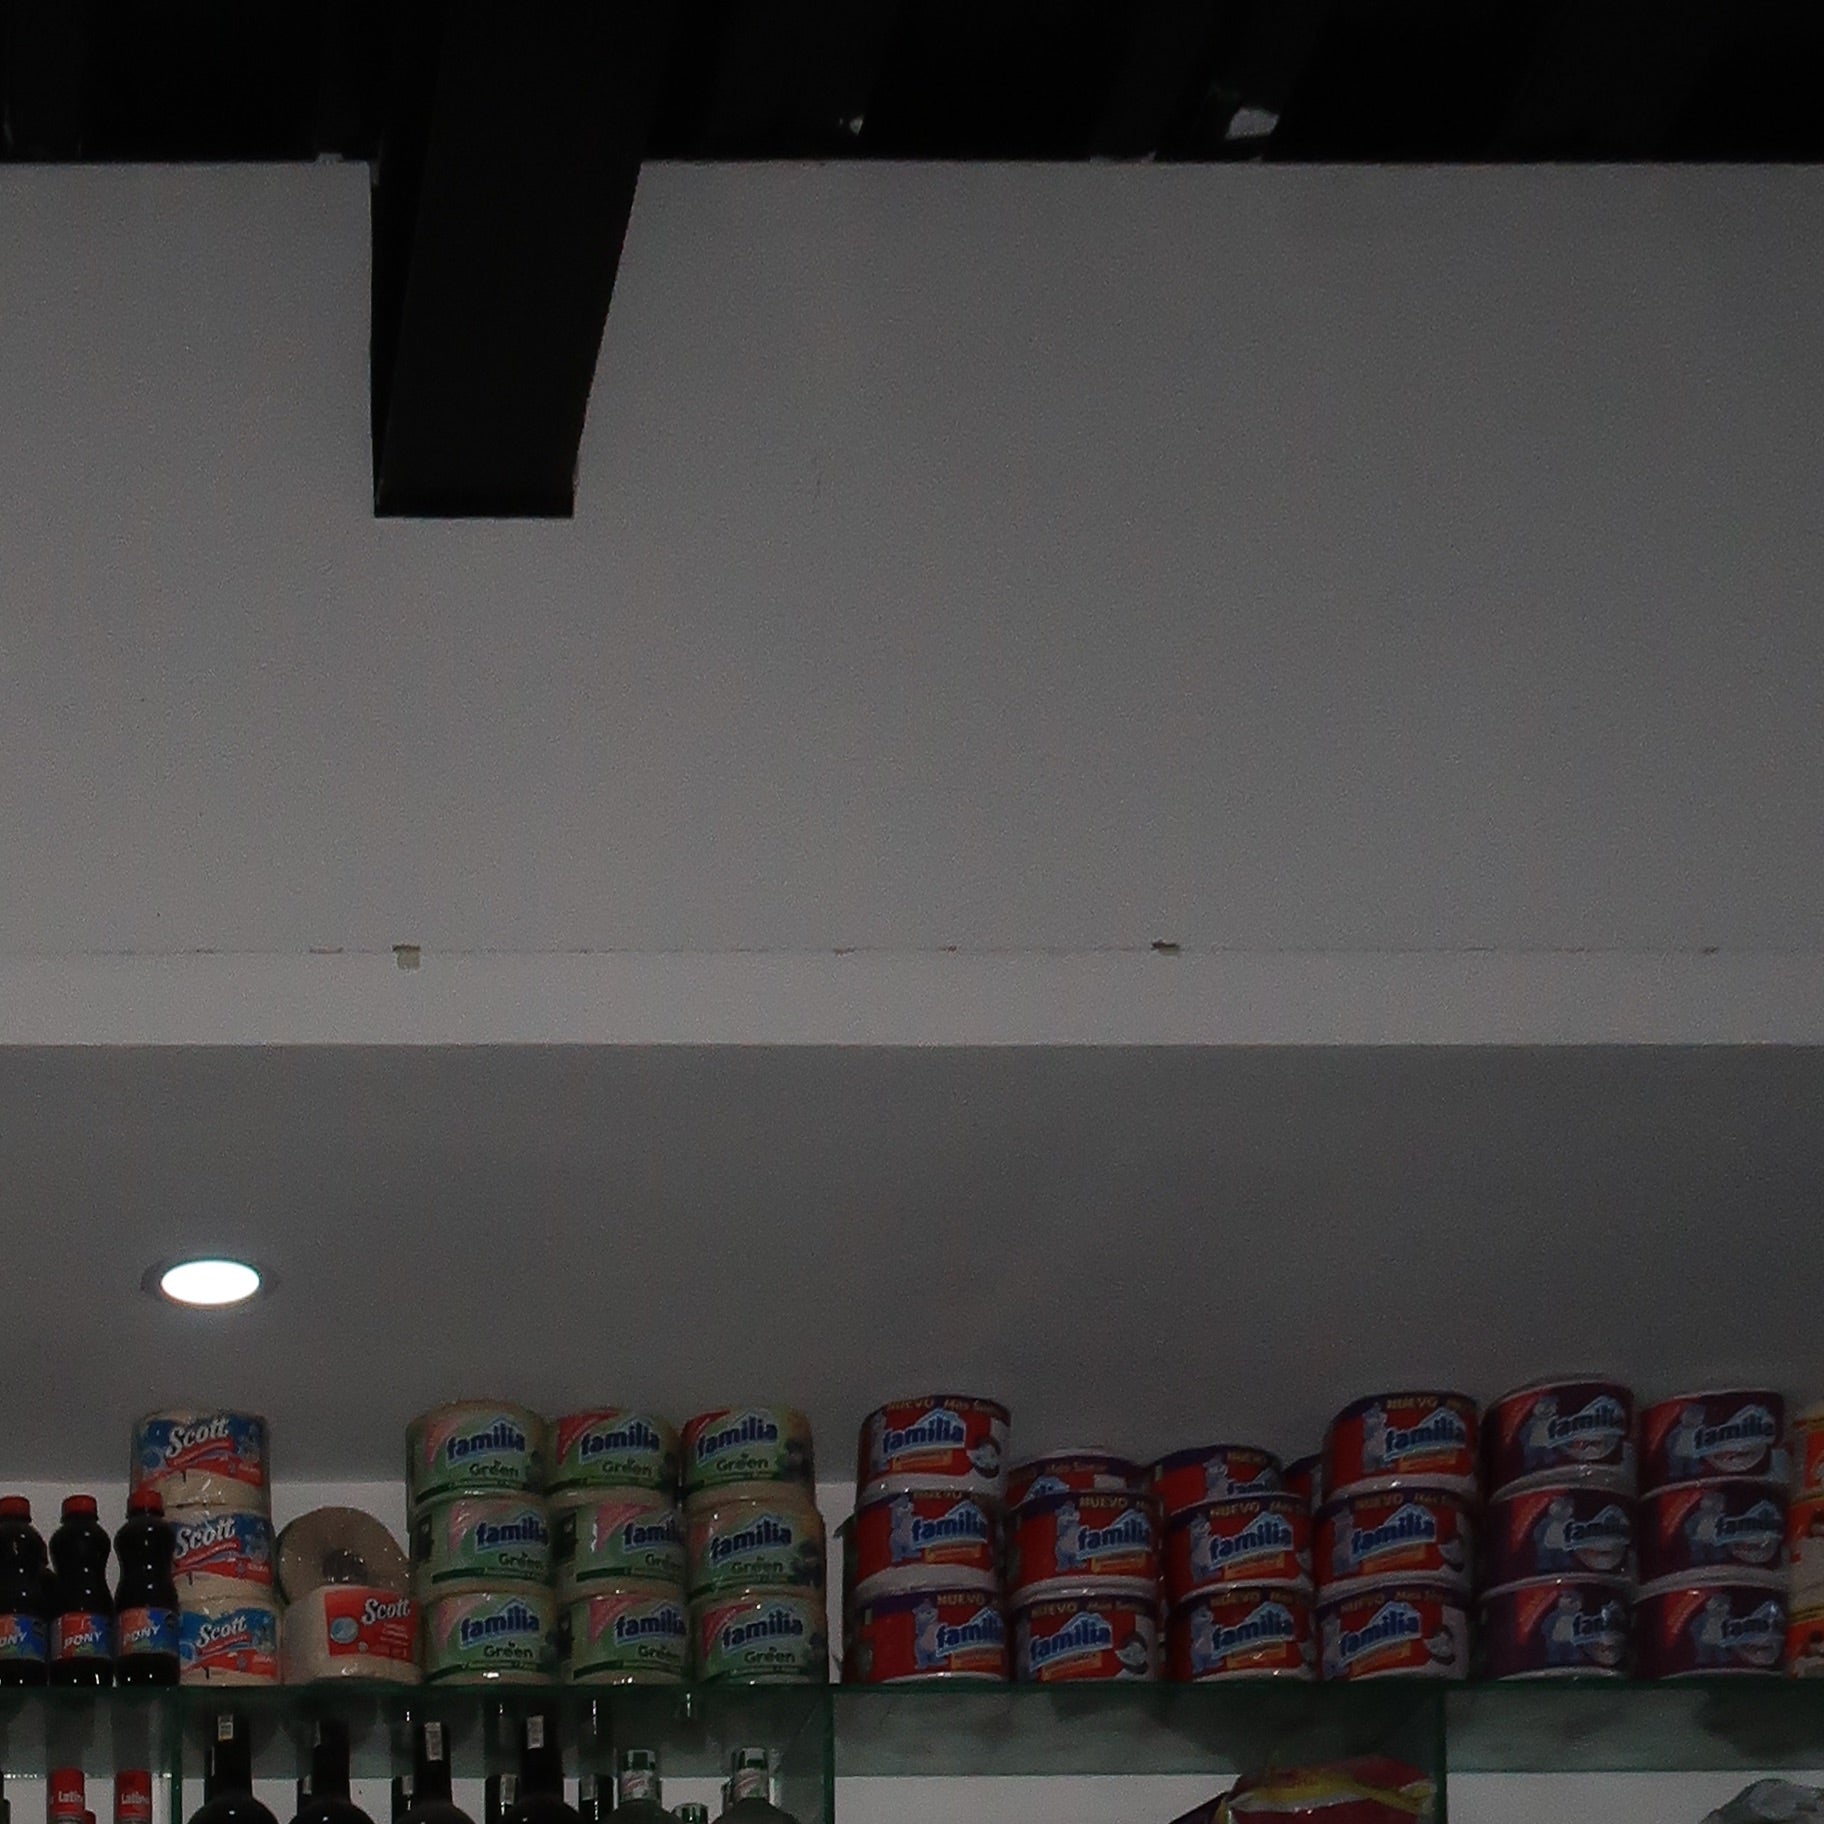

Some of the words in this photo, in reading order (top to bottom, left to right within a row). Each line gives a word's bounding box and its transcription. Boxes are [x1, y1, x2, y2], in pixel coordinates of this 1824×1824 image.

[166, 1416, 230, 1456] Scott
[446, 1419, 526, 1457] familia
[580, 1421, 660, 1456] familia
[697, 1416, 778, 1457] familia
[883, 1415, 966, 1452] familia
[1385, 1414, 1468, 1453] familia
[469, 1461, 520, 1477] Green
[601, 1459, 653, 1475] Green
[715, 1454, 769, 1471] Green
[175, 1515, 237, 1555] Scott
[710, 1521, 793, 1560] familia
[1209, 1522, 1293, 1561] familia
[1351, 1515, 1436, 1555] familia
[361, 1597, 412, 1624] Scott
[460, 1603, 540, 1642] familia
[722, 1608, 804, 1647] familia
[64, 1630, 103, 1650] PONY
[123, 1622, 161, 1647] PONY
[195, 1612, 249, 1648] Scott
[1029, 1622, 1112, 1661] familia
[1212, 1614, 1294, 1652] familia
[1338, 1613, 1422, 1658] familia
[483, 1643, 533, 1659] Green
[742, 1647, 796, 1664] Green
